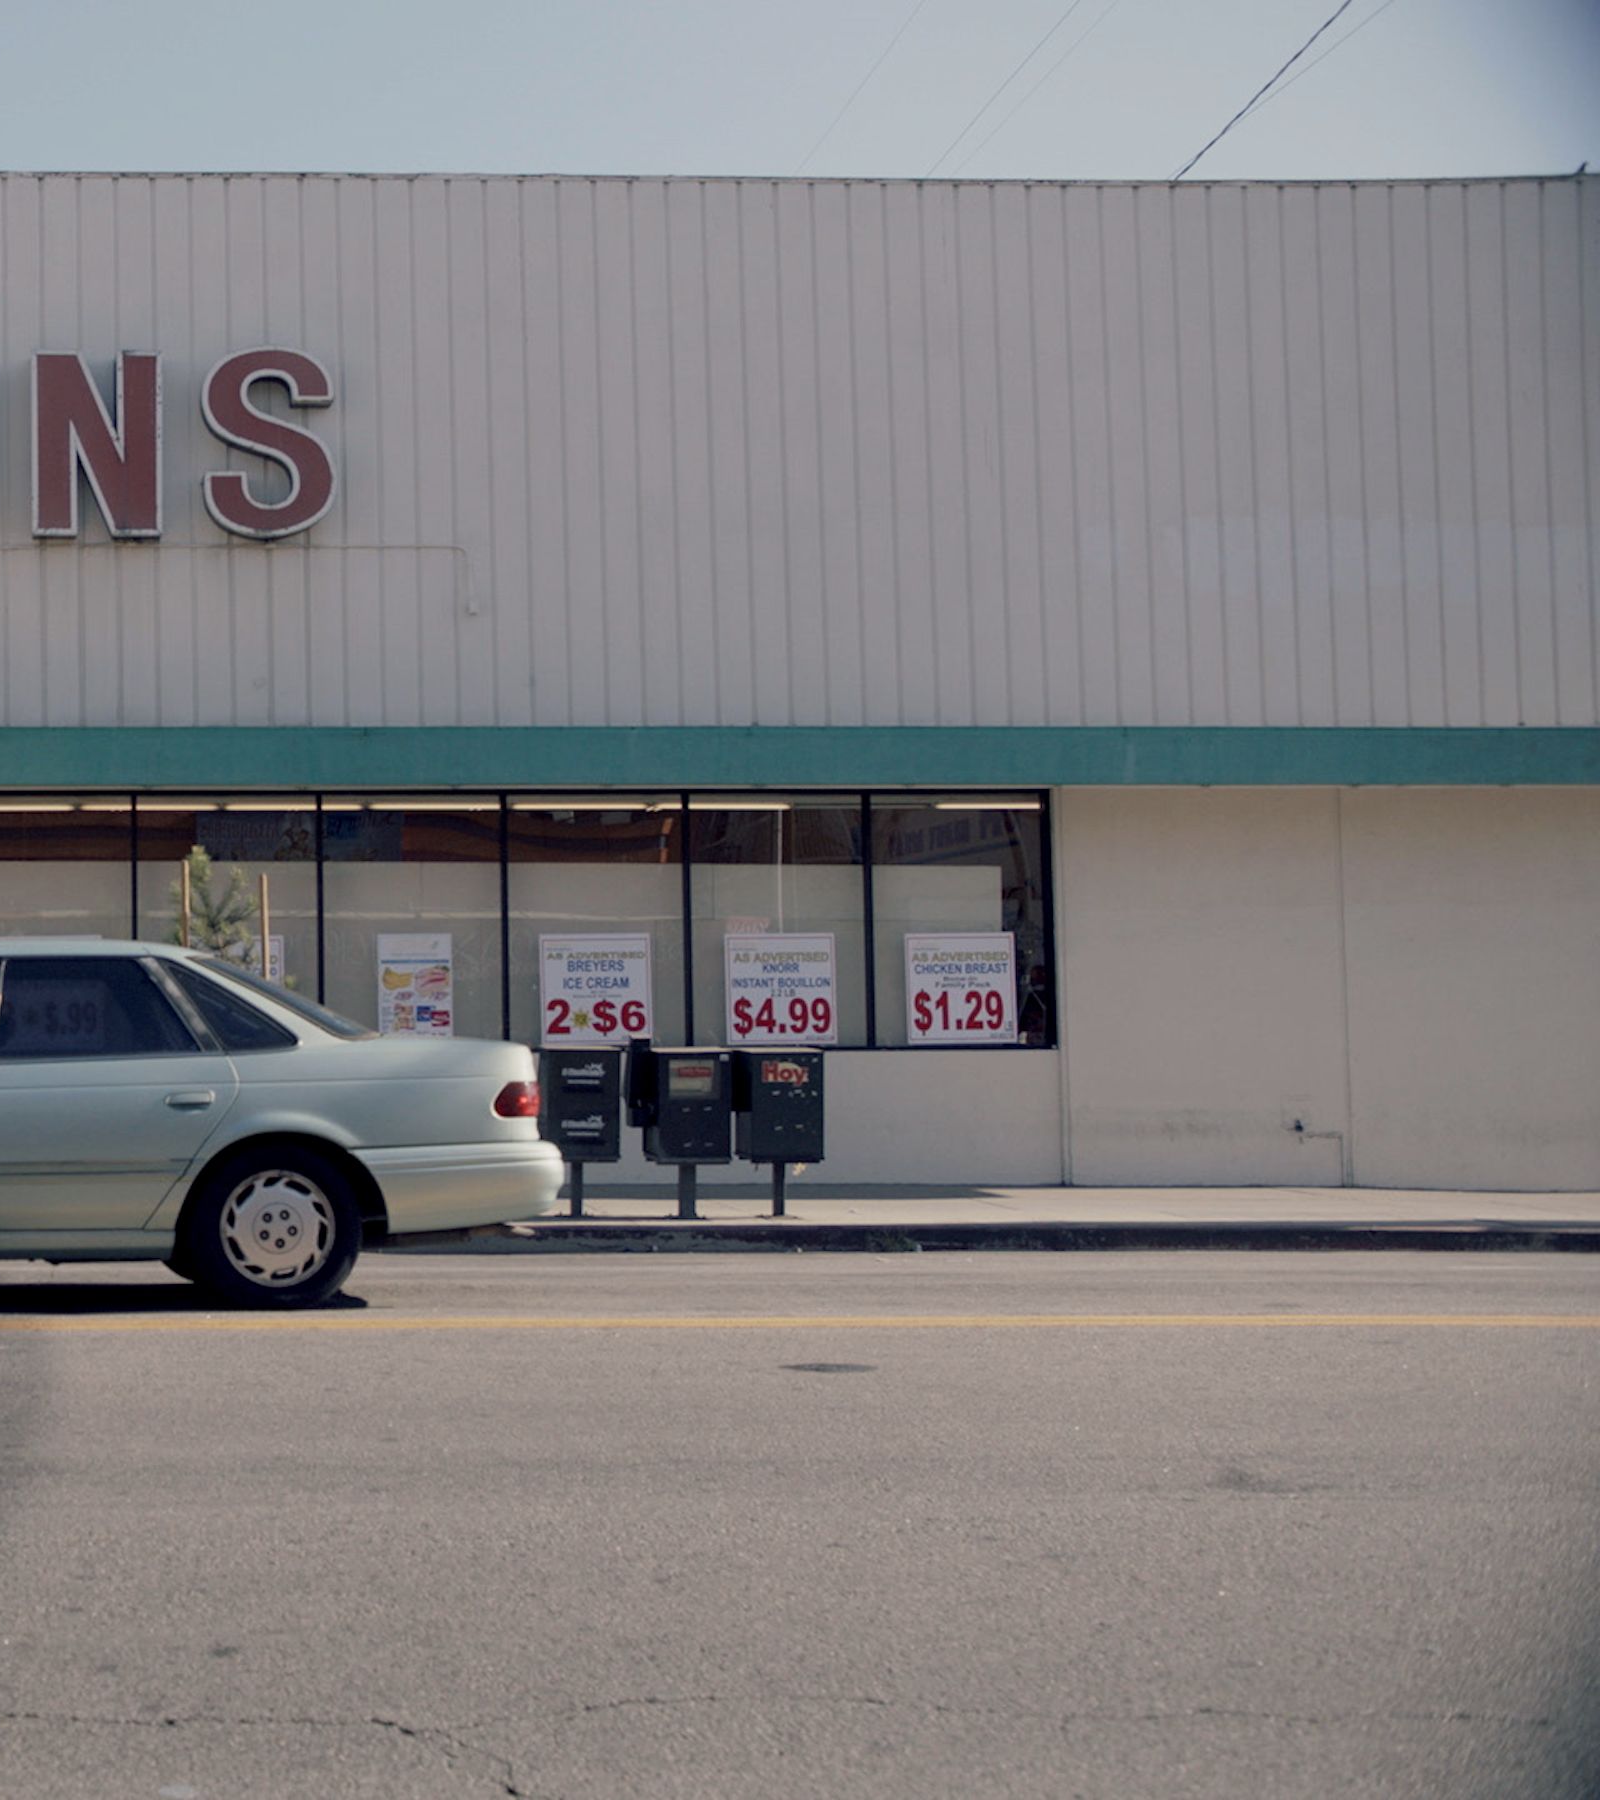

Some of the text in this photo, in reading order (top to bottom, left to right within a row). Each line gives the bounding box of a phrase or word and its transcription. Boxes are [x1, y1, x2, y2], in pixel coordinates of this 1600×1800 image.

[567, 951, 645, 960] ADVERTISED
[734, 952, 830, 962] AS ADVERTISED
[912, 951, 1009, 961] AS ADVERTISED
[567, 960, 625, 973] BREYERS
[762, 963, 800, 973] KNORR
[914, 963, 1008, 974] CHICKEN BREAST
[563, 977, 629, 989] ICE CREAM
[732, 977, 831, 988] INSTANT BOUILLON
[546, 998, 646, 1037] 2 $6
[733, 996, 831, 1039] $4.99
[914, 988, 1004, 1036] $1.29
[762, 1061, 807, 1086] Hoy
